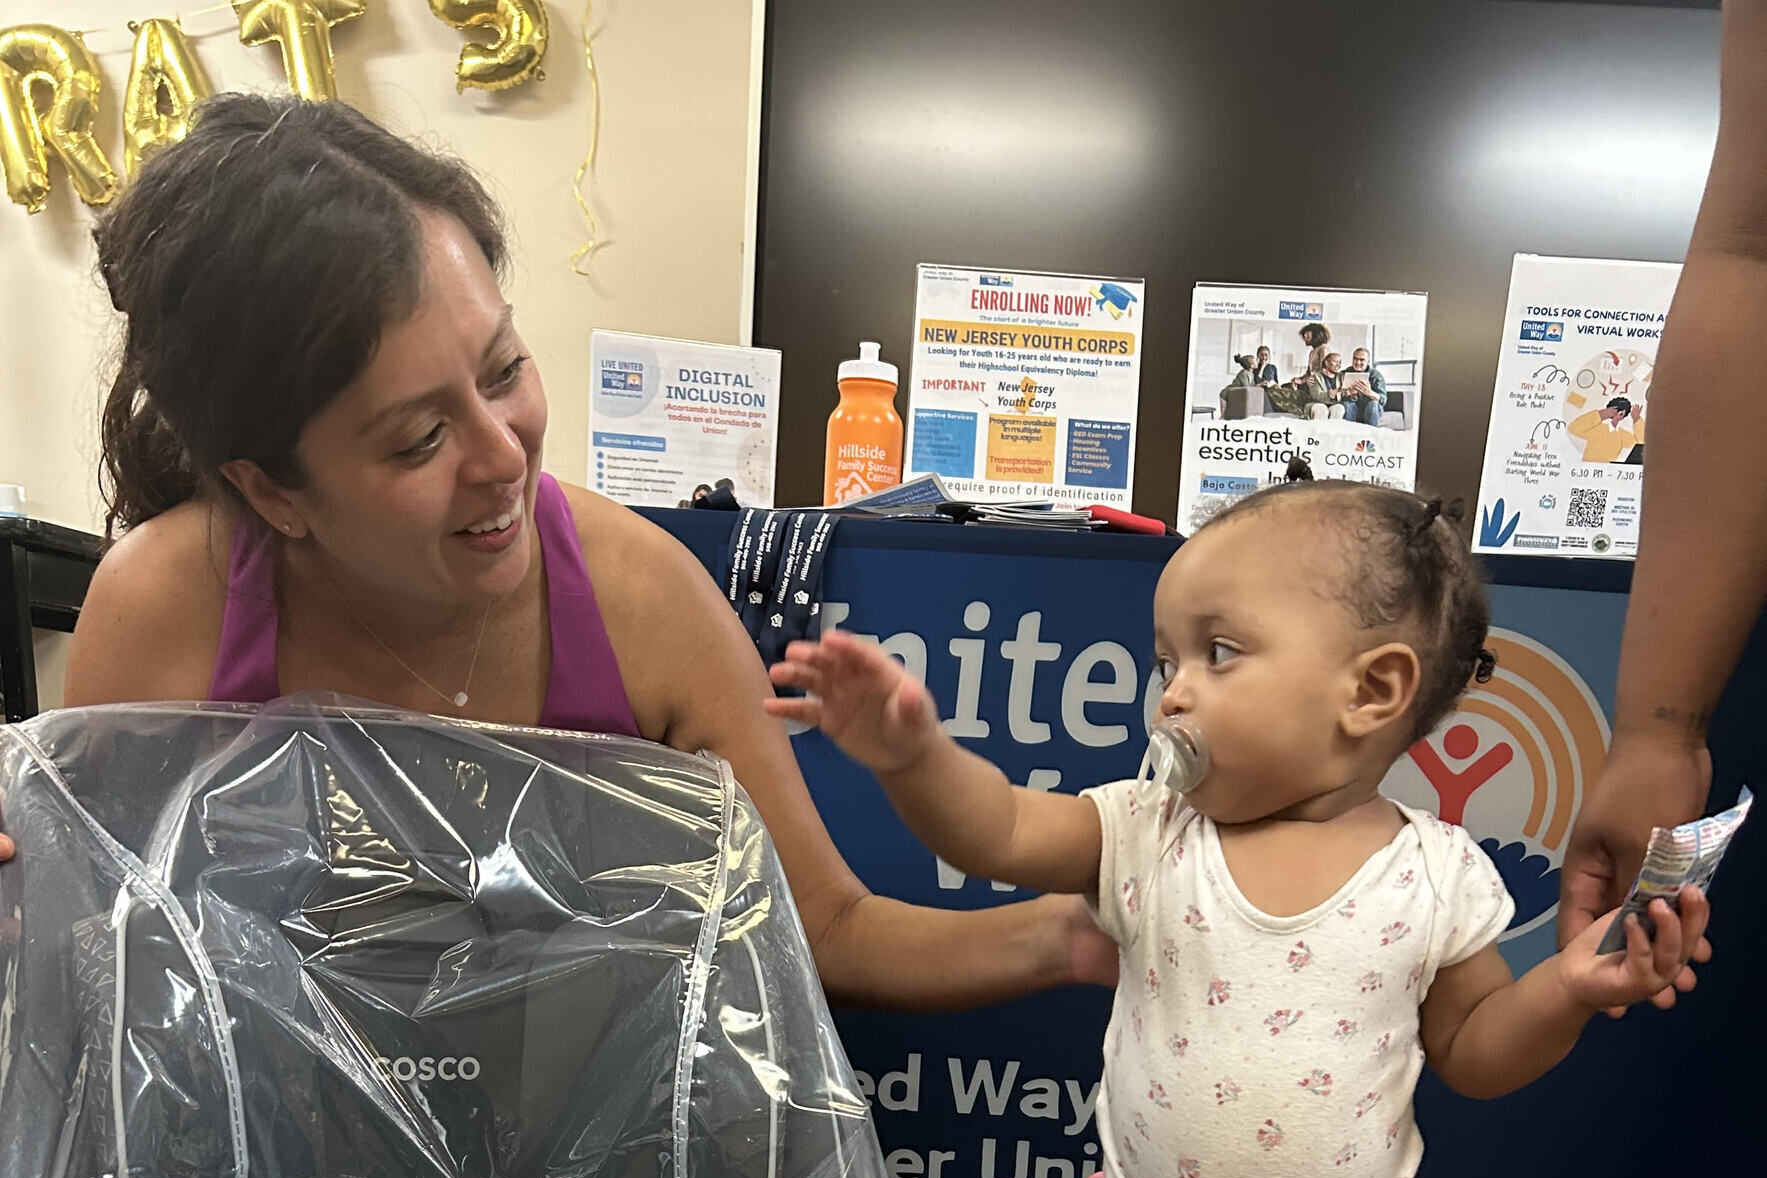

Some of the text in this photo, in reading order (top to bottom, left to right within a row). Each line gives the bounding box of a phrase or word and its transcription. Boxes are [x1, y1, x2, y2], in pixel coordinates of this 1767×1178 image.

[970, 289, 1092, 317] ENROLLING NOW!
[1280, 303, 1305, 319] United Way
[1527, 306, 1559, 317] TOOLS
[1562, 308, 1581, 318] FOR
[1584, 309, 1654, 322] CONNECTION
[1523, 322, 1545, 330] United
[1577, 325, 1623, 337] VIRTUAL
[924, 327, 1128, 354] NEW JERSEY YOUTH CORPS
[1530, 330, 1545, 340] Way
[601, 360, 643, 372] LIVE UNITED
[927, 347, 957, 358] Looking
[959, 348, 970, 357] for
[972, 349, 992, 358] Youth
[994, 350, 1016, 360] 16-25
[1017, 353, 1037, 362] years
[1039, 353, 1051, 362] old
[1052, 354, 1068, 363] who
[1083, 357, 1103, 367] ready
[1104, 359, 1112, 367] to
[1114, 360, 1131, 368] earn
[959, 360, 1098, 378] their Highschool Equivalency Diploma!
[679, 368, 754, 388] DIGITAL
[665, 385, 765, 408] INCLUSION
[922, 379, 1055, 397] IMPORTANT New Jersey
[998, 396, 1057, 412] Youth Corps
[1201, 424, 1320, 447] internet De
[838, 444, 886, 460] Hillside
[1199, 444, 1312, 465] essentials
[1325, 453, 1405, 468] COMCAST
[838, 460, 865, 473] Family
[989, 483, 1020, 496] proof
[1026, 485, 1037, 496] of
[1042, 486, 1124, 502] identification
[1203, 479, 1225, 490] Bajo
[948, 1057, 1100, 1136] Way
